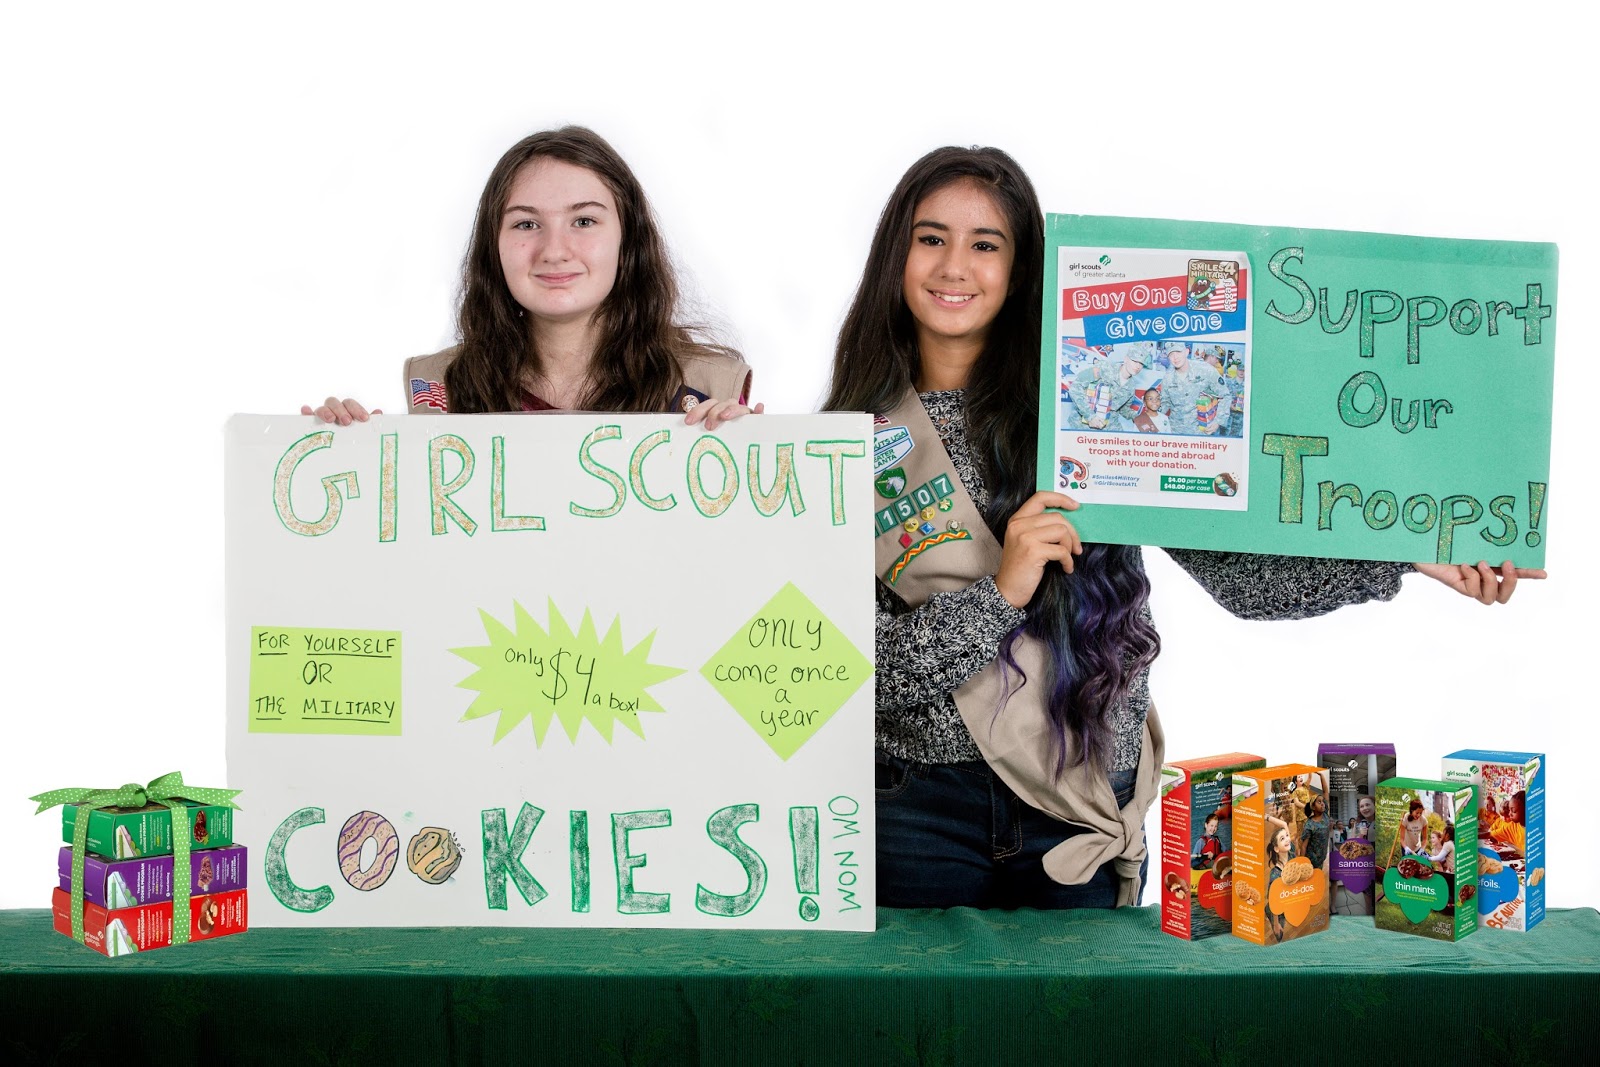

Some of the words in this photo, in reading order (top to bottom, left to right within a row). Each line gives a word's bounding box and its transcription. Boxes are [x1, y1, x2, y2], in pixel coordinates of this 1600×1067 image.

[1069, 262, 1080, 271] girl
[1190, 271, 1229, 279] MILITARY
[1072, 290, 1125, 313] Buy
[1130, 285, 1182, 306] One
[1265, 247, 1552, 364] Support
[1106, 315, 1166, 339] Give
[1169, 312, 1222, 333] One
[1338, 370, 1453, 434] Our
[891, 431, 906, 443] USA
[1077, 436, 1098, 445] Give
[1100, 437, 1130, 447] smiles
[1132, 439, 1142, 447] to
[1161, 440, 1189, 449] brave
[1190, 441, 1228, 452] military
[874, 449, 895, 463] EATER
[874, 455, 897, 469] LANTA
[1089, 447, 1120, 458] troops
[1122, 449, 1132, 457] at
[1133, 449, 1160, 458] home
[1161, 450, 1179, 459] and
[1181, 451, 1216, 461] abroad
[1106, 458, 1127, 467] with
[1128, 459, 1150, 469] your
[1152, 460, 1197, 470] donation.
[273, 430, 547, 543] GIRL
[569, 425, 866, 526] SCOUT
[882, 478, 947, 526] 1507
[1263, 434, 1547, 565] Troops!
[258, 632, 290, 649] FOR
[304, 634, 396, 654] YOURSELF
[302, 660, 333, 685] OR
[542, 647, 596, 705] $4
[592, 693, 602, 705] a
[609, 697, 640, 716] box!
[714, 663, 778, 684] come
[790, 663, 850, 684] once
[256, 695, 287, 715] THE
[303, 698, 395, 718] MILITARY
[774, 689, 792, 704] a
[760, 708, 819, 737] year
[1394, 881, 1411, 891] thin
